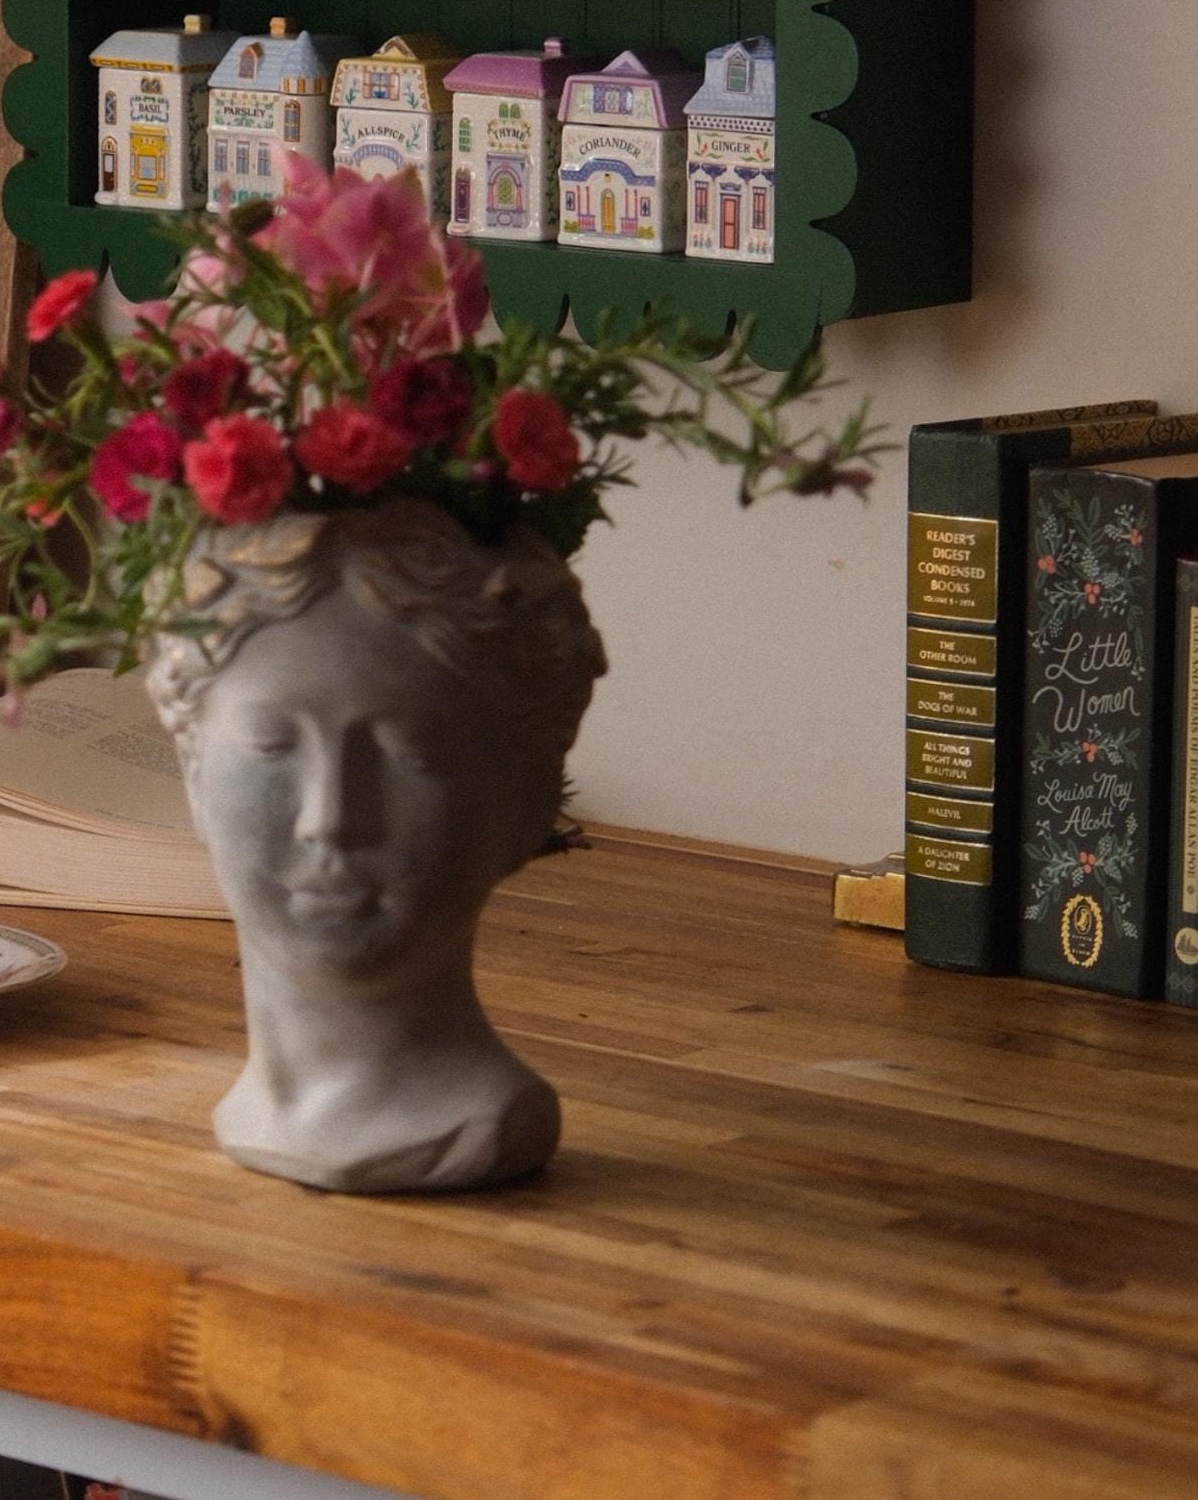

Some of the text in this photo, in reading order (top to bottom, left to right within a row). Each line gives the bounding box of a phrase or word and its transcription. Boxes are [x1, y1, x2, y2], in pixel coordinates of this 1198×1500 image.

[138, 103, 163, 114] BASIL
[223, 106, 266, 118] PARSLEY
[357, 127, 405, 142] ALLSPICE
[493, 129, 525, 142] THYME
[579, 137, 642, 158] CORIANDER
[711, 140, 751, 153] GINGER
[926, 530, 976, 546] READER'S
[932, 547, 971, 562] DIGEST
[918, 562, 986, 579] CONDENSED
[930, 580, 970, 593] BOOKS
[939, 641, 955, 651] THE
[919, 650, 977, 665] OTHER ROOM
[1044, 631, 1133, 685] Little
[938, 691, 954, 701] THE
[917, 700, 977, 716] DOGS OF WAR
[1032, 686, 1142, 733] Women
[923, 741, 970, 756] ALL THINGS
[952, 756, 972, 768] AND
[925, 765, 968, 779] BEAUTIFUL
[1037, 771, 1136, 813] Louisa May
[1059, 805, 1115, 837] Alcott
[1188, 807, 1197, 848] ALLAN
[925, 859, 936, 869] OF
[1187, 852, 1196, 879] POE
